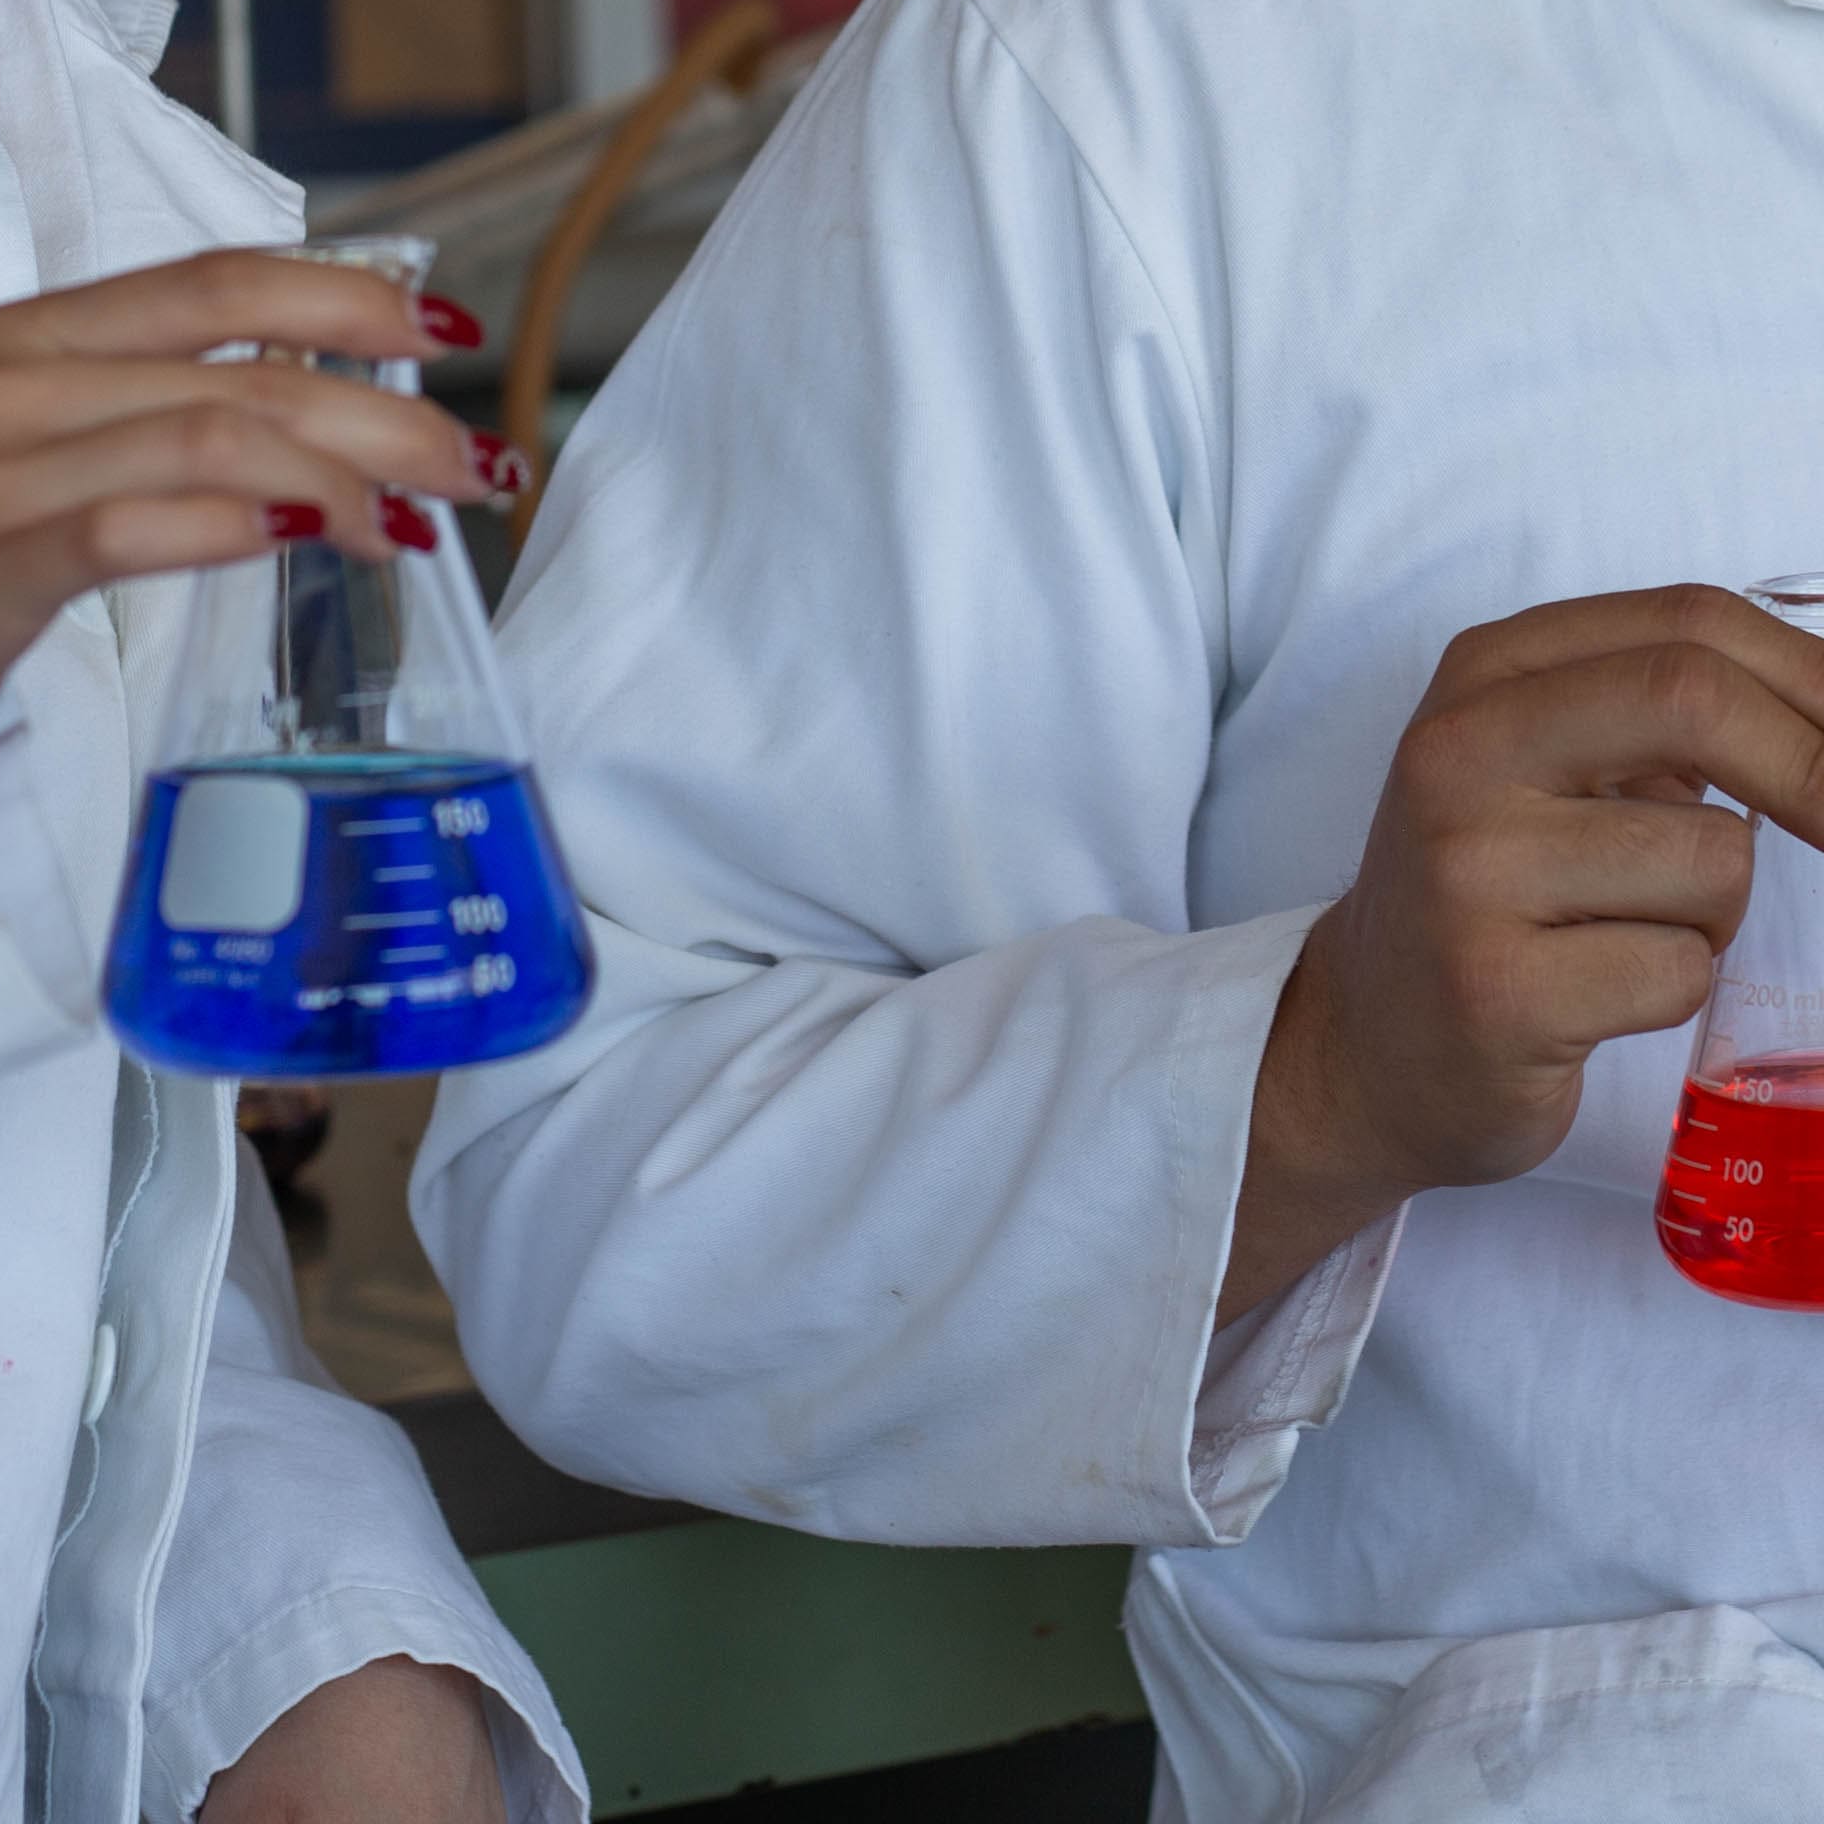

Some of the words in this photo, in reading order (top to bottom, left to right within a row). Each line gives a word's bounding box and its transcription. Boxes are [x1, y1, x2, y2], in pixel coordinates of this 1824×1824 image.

[432, 798, 489, 838] 150
[449, 894, 508, 935] 100
[1744, 982, 1787, 1009] 200
[1733, 1076, 1773, 1103] 150
[1723, 1157, 1763, 1185] 100
[1724, 1216, 1754, 1242] 50
